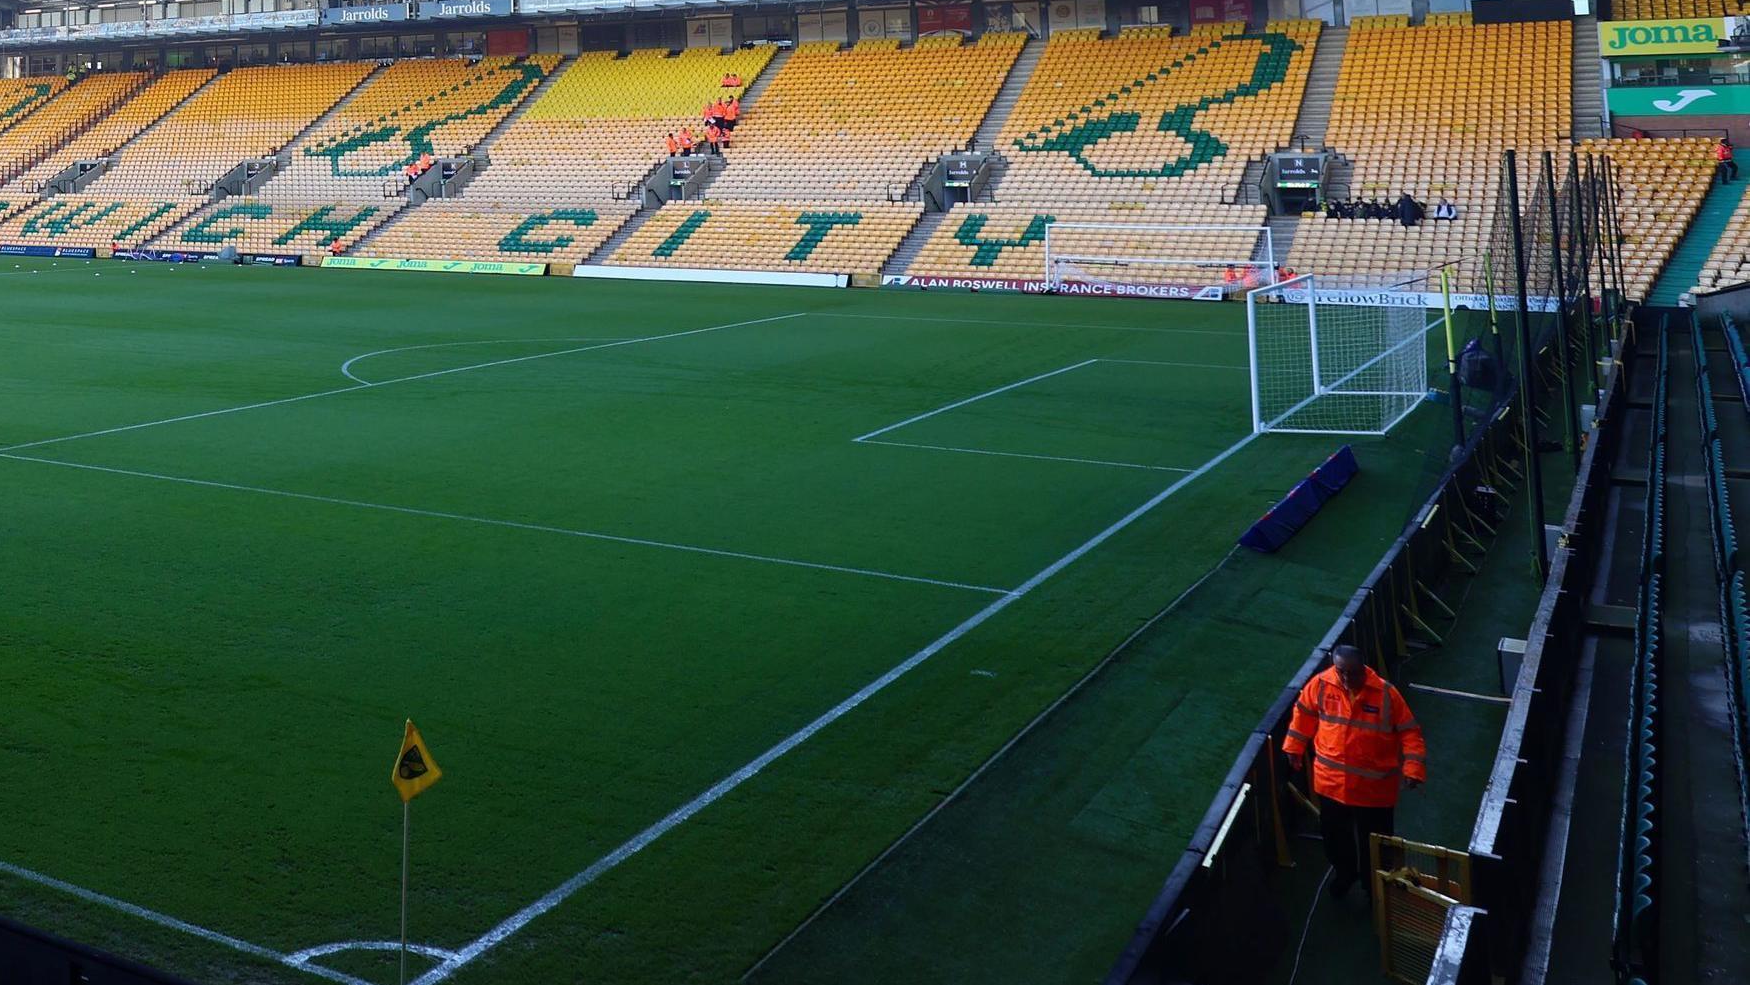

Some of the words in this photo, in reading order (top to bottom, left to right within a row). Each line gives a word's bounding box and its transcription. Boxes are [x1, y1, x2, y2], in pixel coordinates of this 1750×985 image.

[340, 7, 388, 22] Jarrolds
[440, 1, 491, 15] Jarrolds
[910, 277, 949, 287] ALAN
[953, 278, 1019, 290] BOSWELL
[1117, 285, 1189, 297] BROKERS
